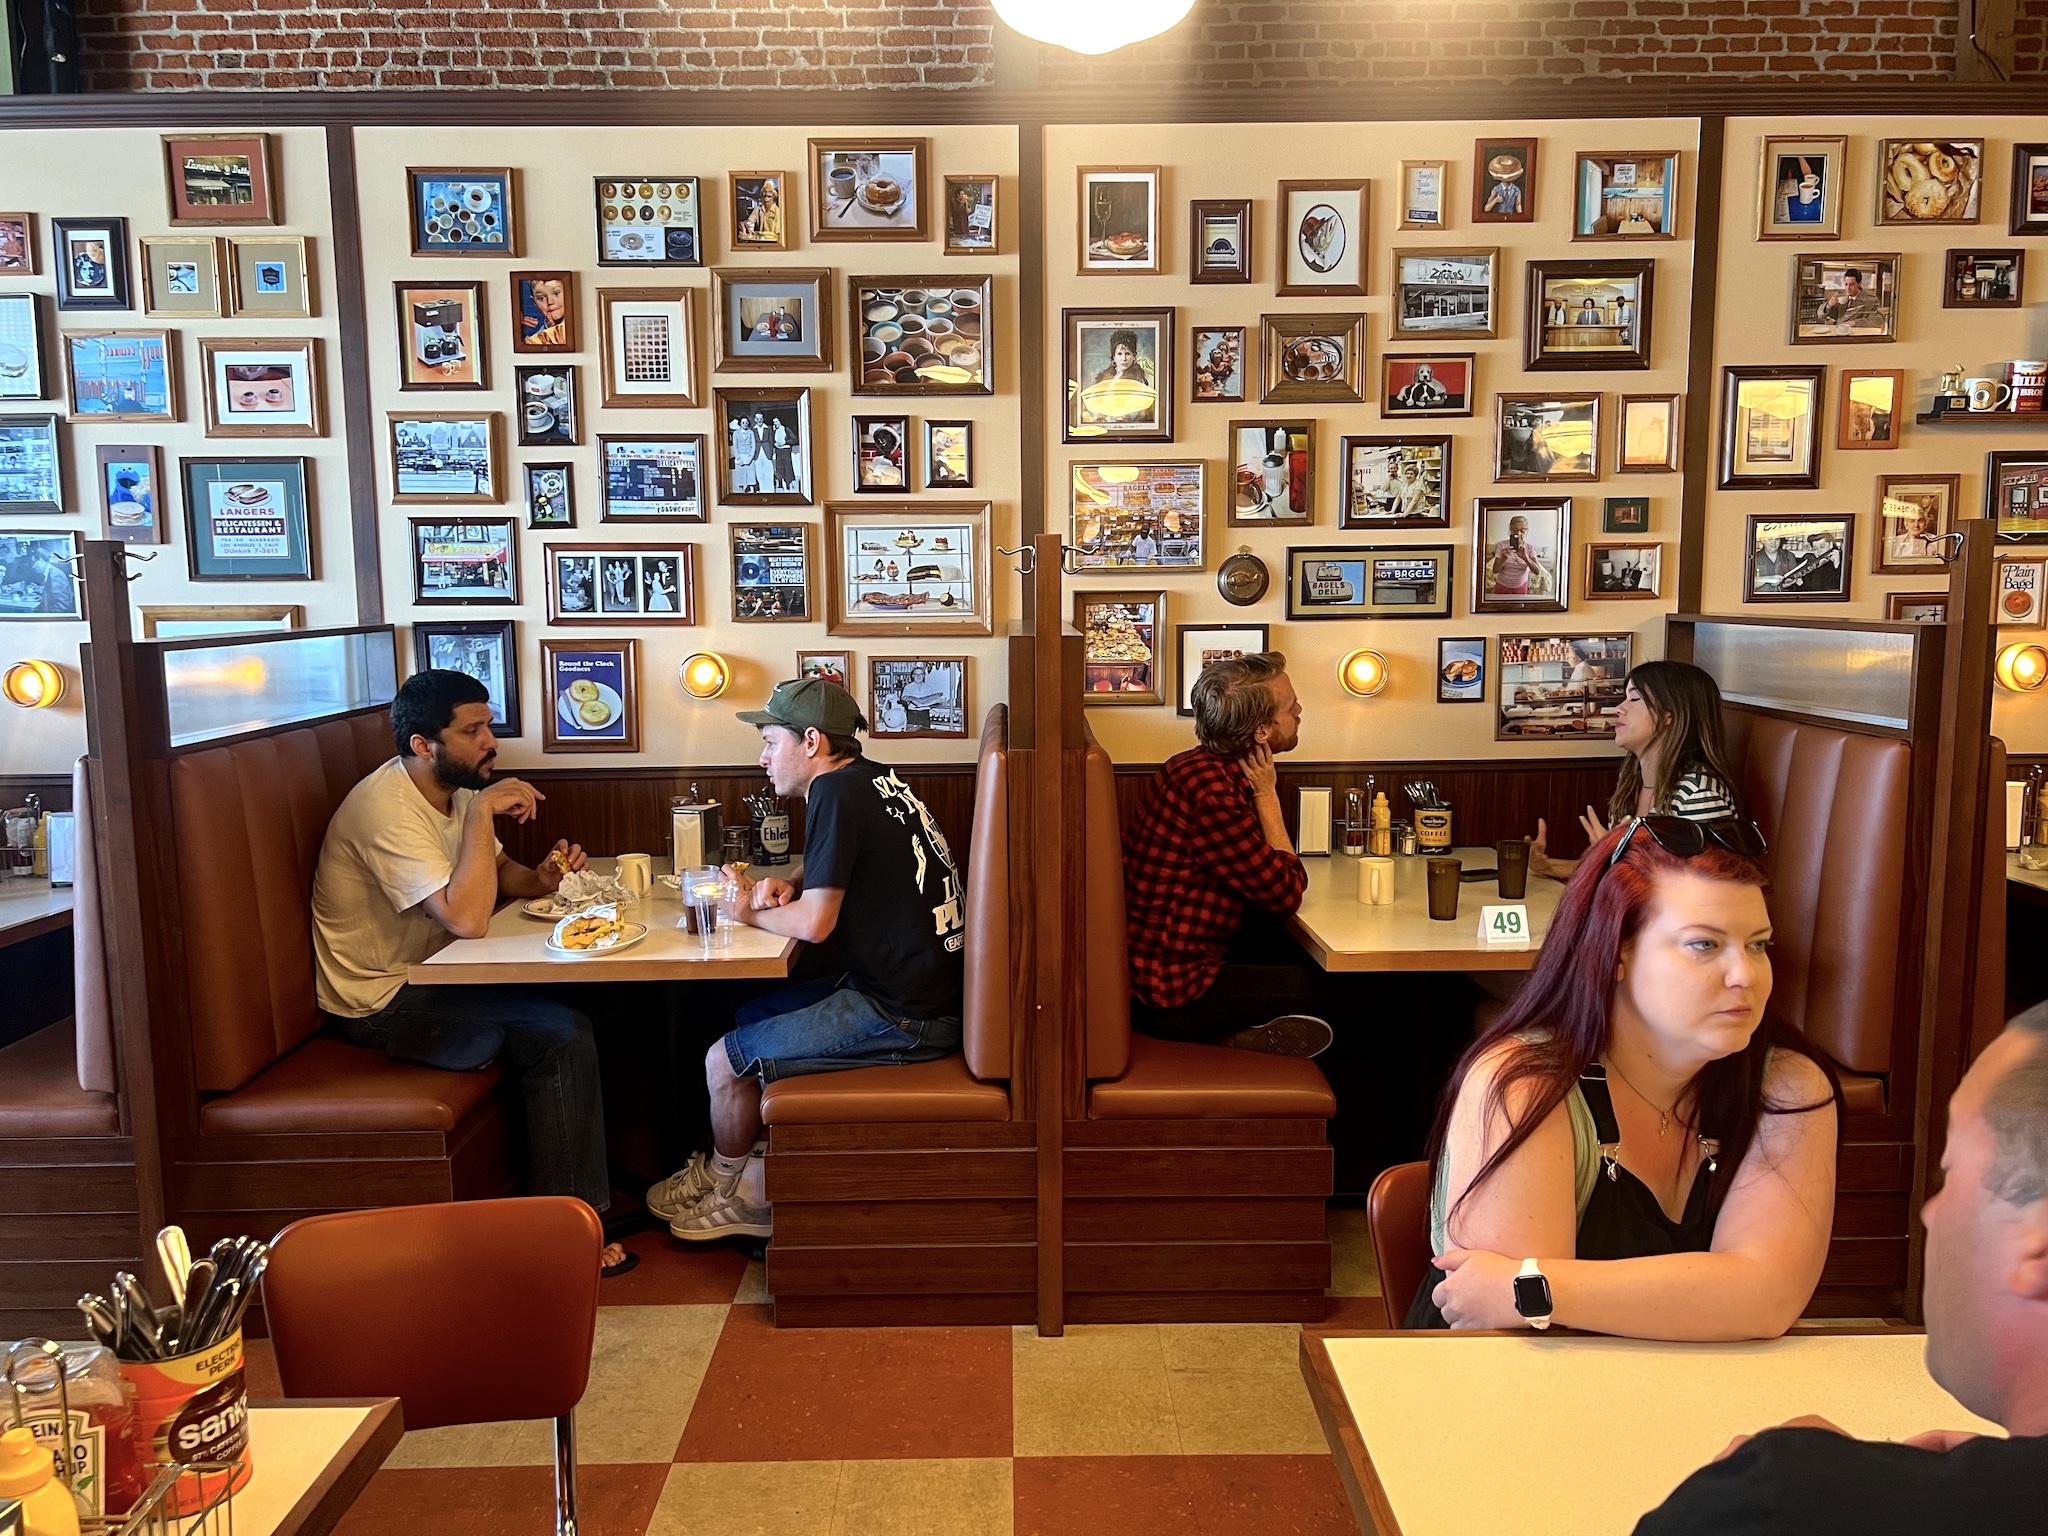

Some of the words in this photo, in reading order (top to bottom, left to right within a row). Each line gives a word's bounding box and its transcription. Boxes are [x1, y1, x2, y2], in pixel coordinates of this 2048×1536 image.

[547, 486, 560, 494] BOY
[1394, 569, 1435, 578] BAGELS
[2002, 565, 2035, 577] Plain
[1312, 581, 1345, 589] BAGELS
[2004, 576, 2034, 591] Bagel
[763, 826, 789, 841] Ehler
[1493, 911, 1521, 934] 49
[209, 1354, 236, 1377] PERK
[30, 1421, 72, 1438] EIN
